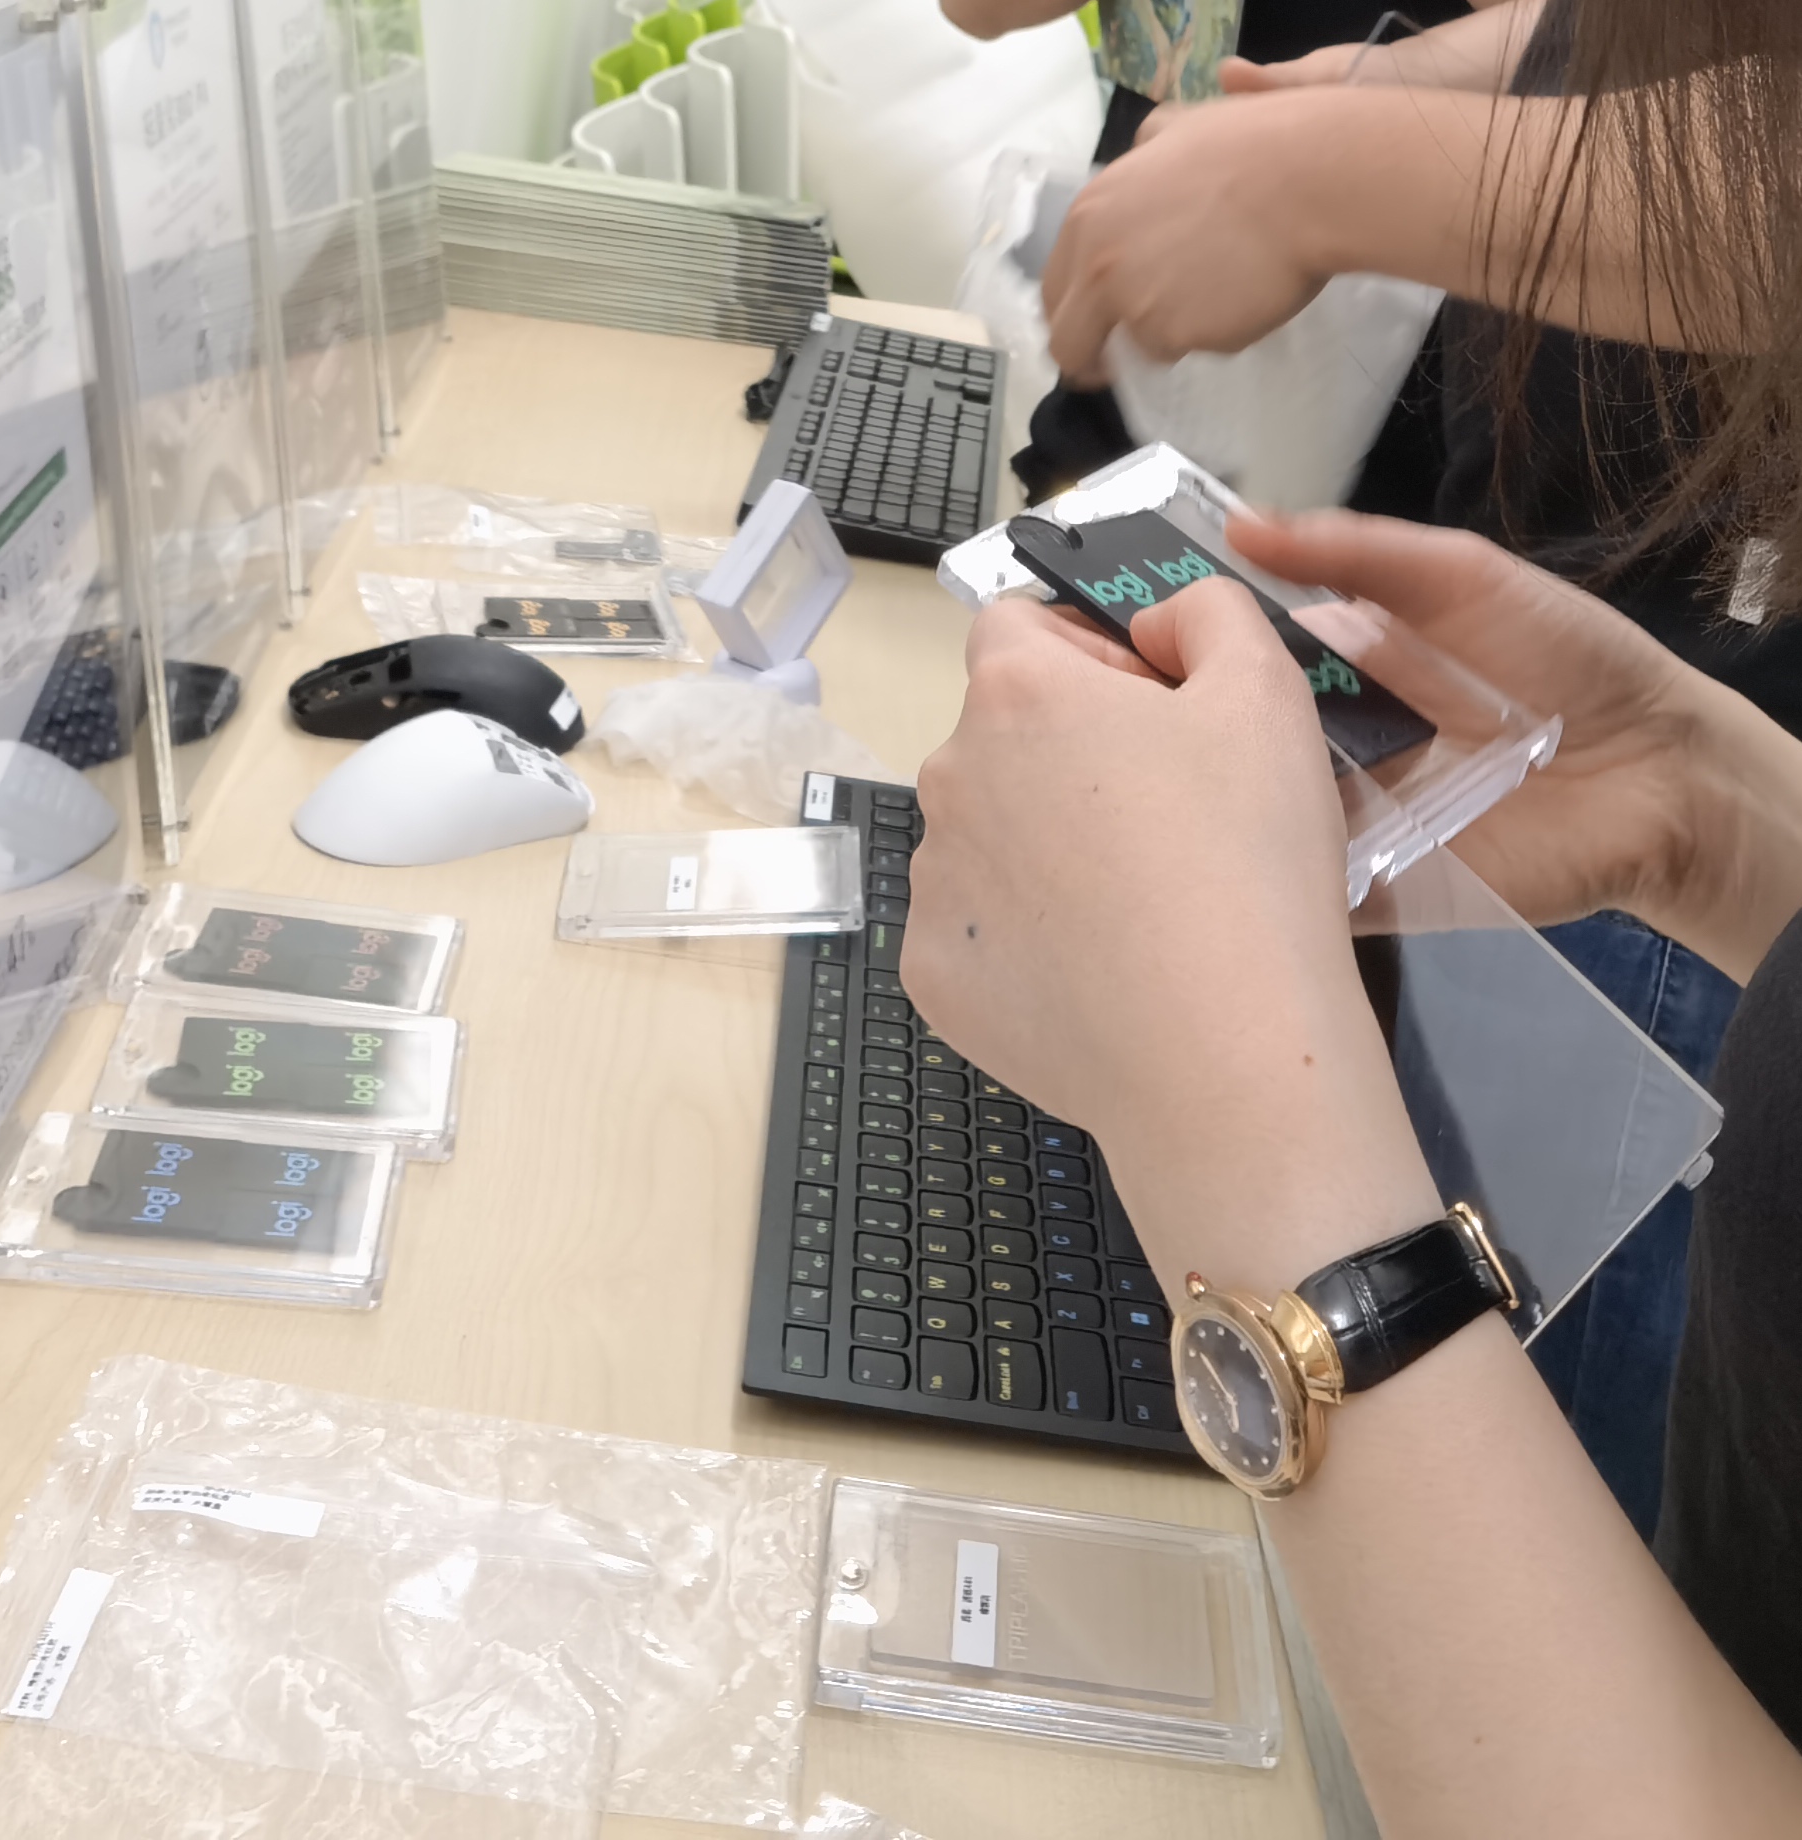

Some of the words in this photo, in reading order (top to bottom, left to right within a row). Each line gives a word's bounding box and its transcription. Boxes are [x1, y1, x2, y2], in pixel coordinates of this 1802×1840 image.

[1075, 564, 1156, 607] logi
[228, 1026, 266, 1057] logi
[345, 1032, 383, 1062] logi
[925, 1055, 942, 1063] O
[222, 1064, 265, 1096] logi
[345, 1073, 385, 1105] logi
[984, 1085, 1002, 1094] K
[927, 1113, 944, 1121] U
[985, 1115, 1002, 1123] J
[927, 1143, 945, 1151] Y
[1045, 1137, 1061, 1147] N
[987, 1144, 1003, 1154] H
[145, 1142, 193, 1177] logi
[274, 1152, 321, 1186] logi
[927, 1174, 945, 1182] T
[132, 1186, 181, 1223] logi
[1049, 1201, 1068, 1210] V
[265, 1201, 312, 1237] logi
[1051, 1234, 1070, 1245] C
[928, 1243, 946, 1253] E
[991, 1244, 1010, 1254] D
[928, 1275, 946, 1289] W
[1055, 1271, 1074, 1282] X
[991, 1281, 1011, 1292] S
[1057, 1309, 1077, 1320] Z
[927, 1318, 946, 1329] Q
[994, 1320, 1012, 1330] A
